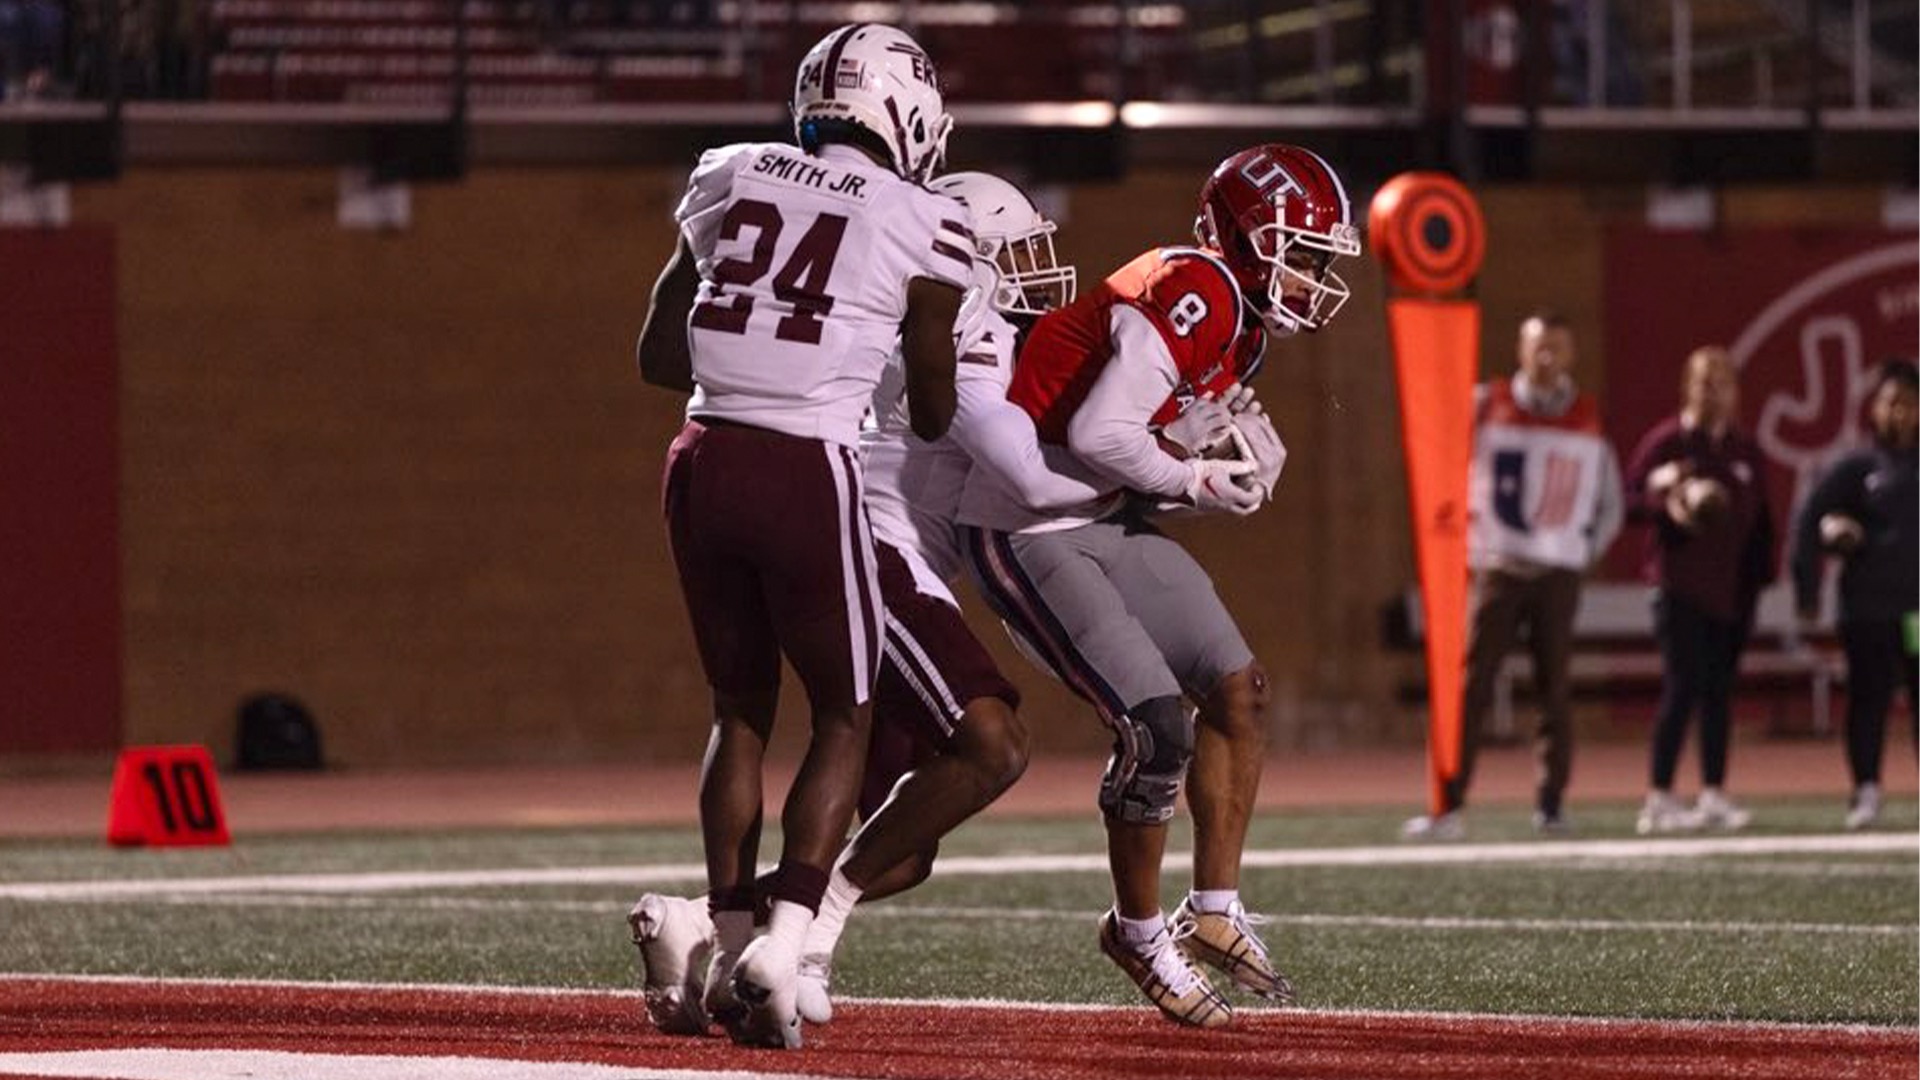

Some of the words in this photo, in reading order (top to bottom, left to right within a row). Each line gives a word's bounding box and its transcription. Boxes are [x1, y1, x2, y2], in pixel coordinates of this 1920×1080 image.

[800, 60, 824, 93] 24
[911, 56, 938, 91] EK
[754, 154, 828, 188] SMITH
[828, 173, 867, 198] JR.
[1240, 153, 1308, 202] UT
[690, 198, 849, 345] 24
[1168, 292, 1208, 337] 8
[142, 760, 217, 835] 10
